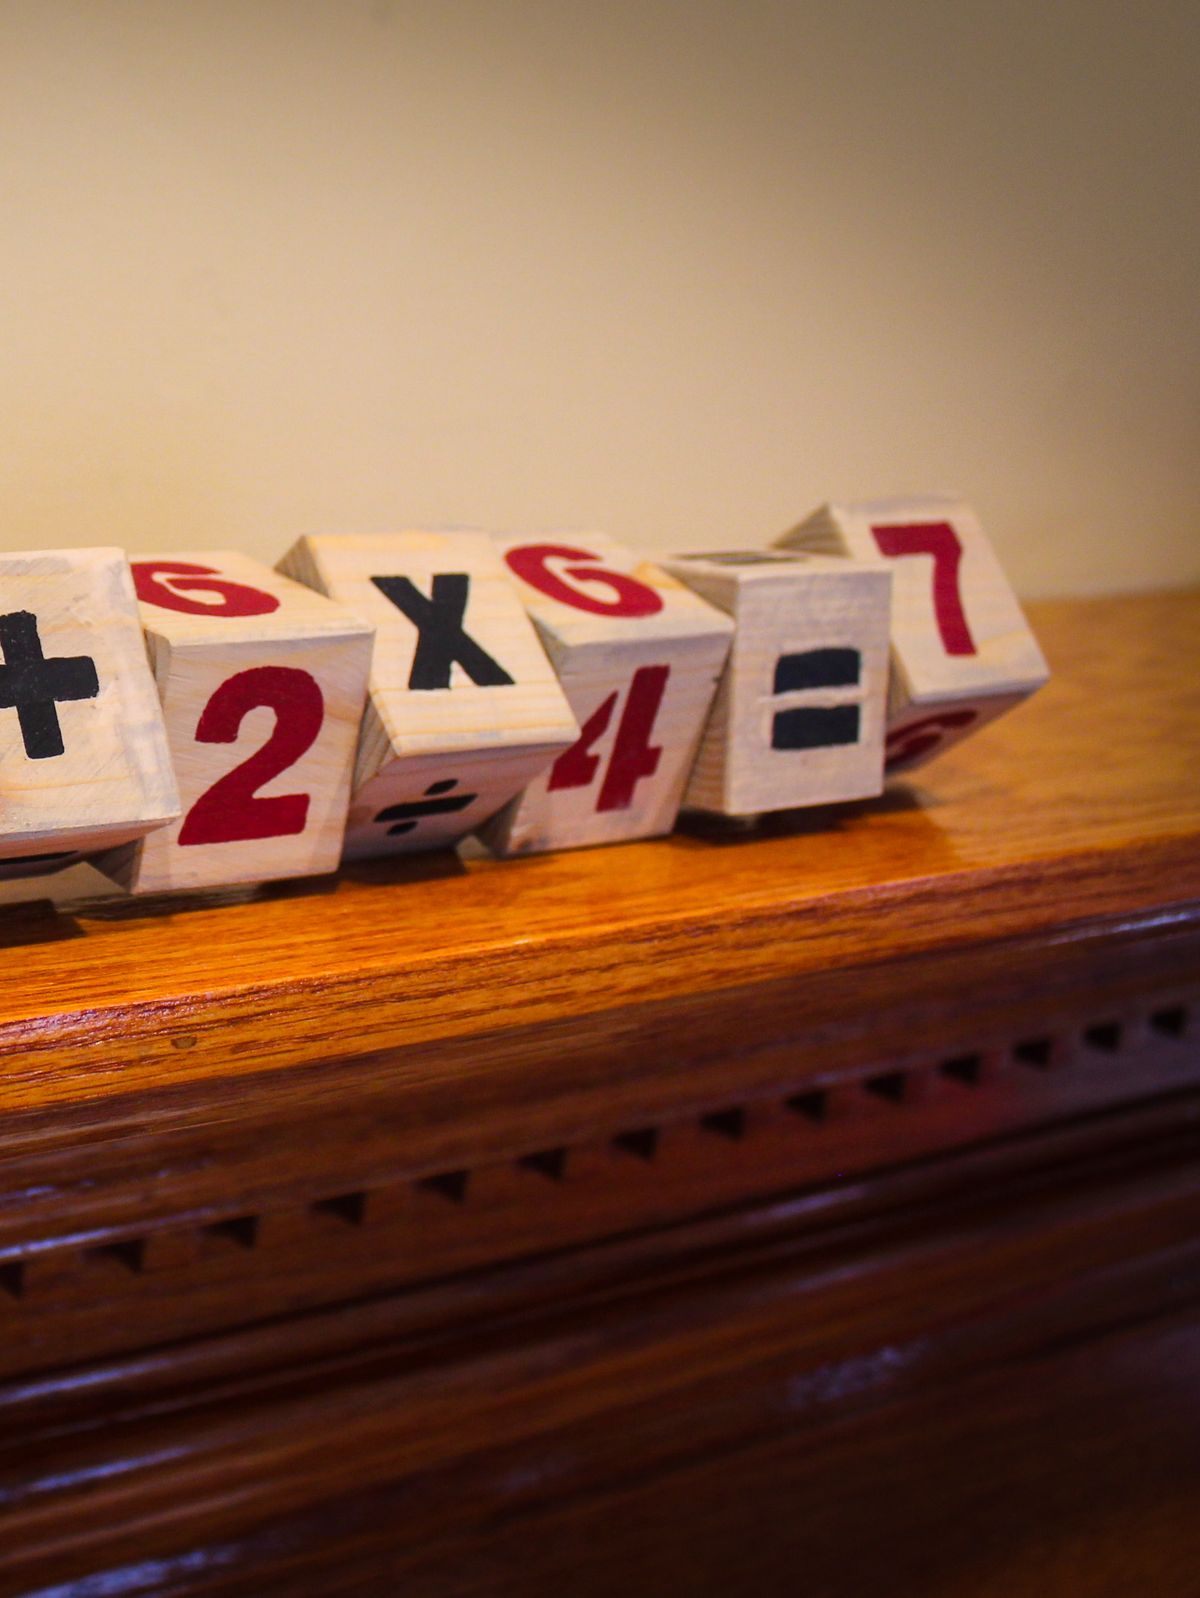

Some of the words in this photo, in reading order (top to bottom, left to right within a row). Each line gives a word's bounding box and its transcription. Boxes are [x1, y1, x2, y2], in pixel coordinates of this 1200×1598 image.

[131, 559, 281, 619] 6
[505, 543, 665, 619] 6
[871, 520, 978, 658] 7
[176, 664, 326, 848] 2
[546, 663, 672, 814] 4
